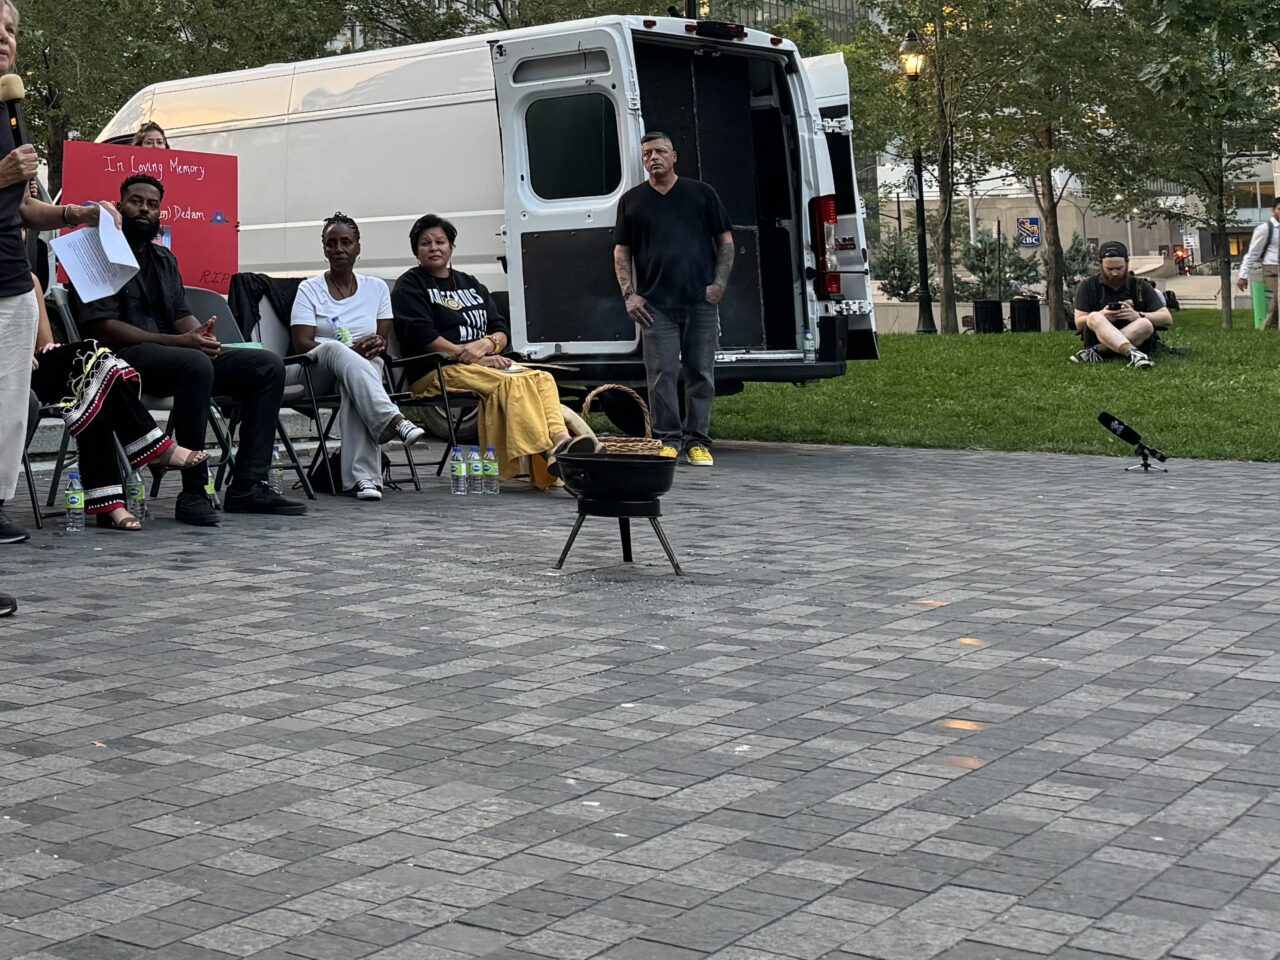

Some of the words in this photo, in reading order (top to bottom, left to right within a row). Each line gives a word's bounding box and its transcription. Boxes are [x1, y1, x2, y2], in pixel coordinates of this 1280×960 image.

[102, 155, 125, 172] In
[130, 155, 163, 181] Loving
[169, 155, 205, 181] Memory
[173, 204, 205, 221] Dedam
[199, 269, 230, 284] RIP
